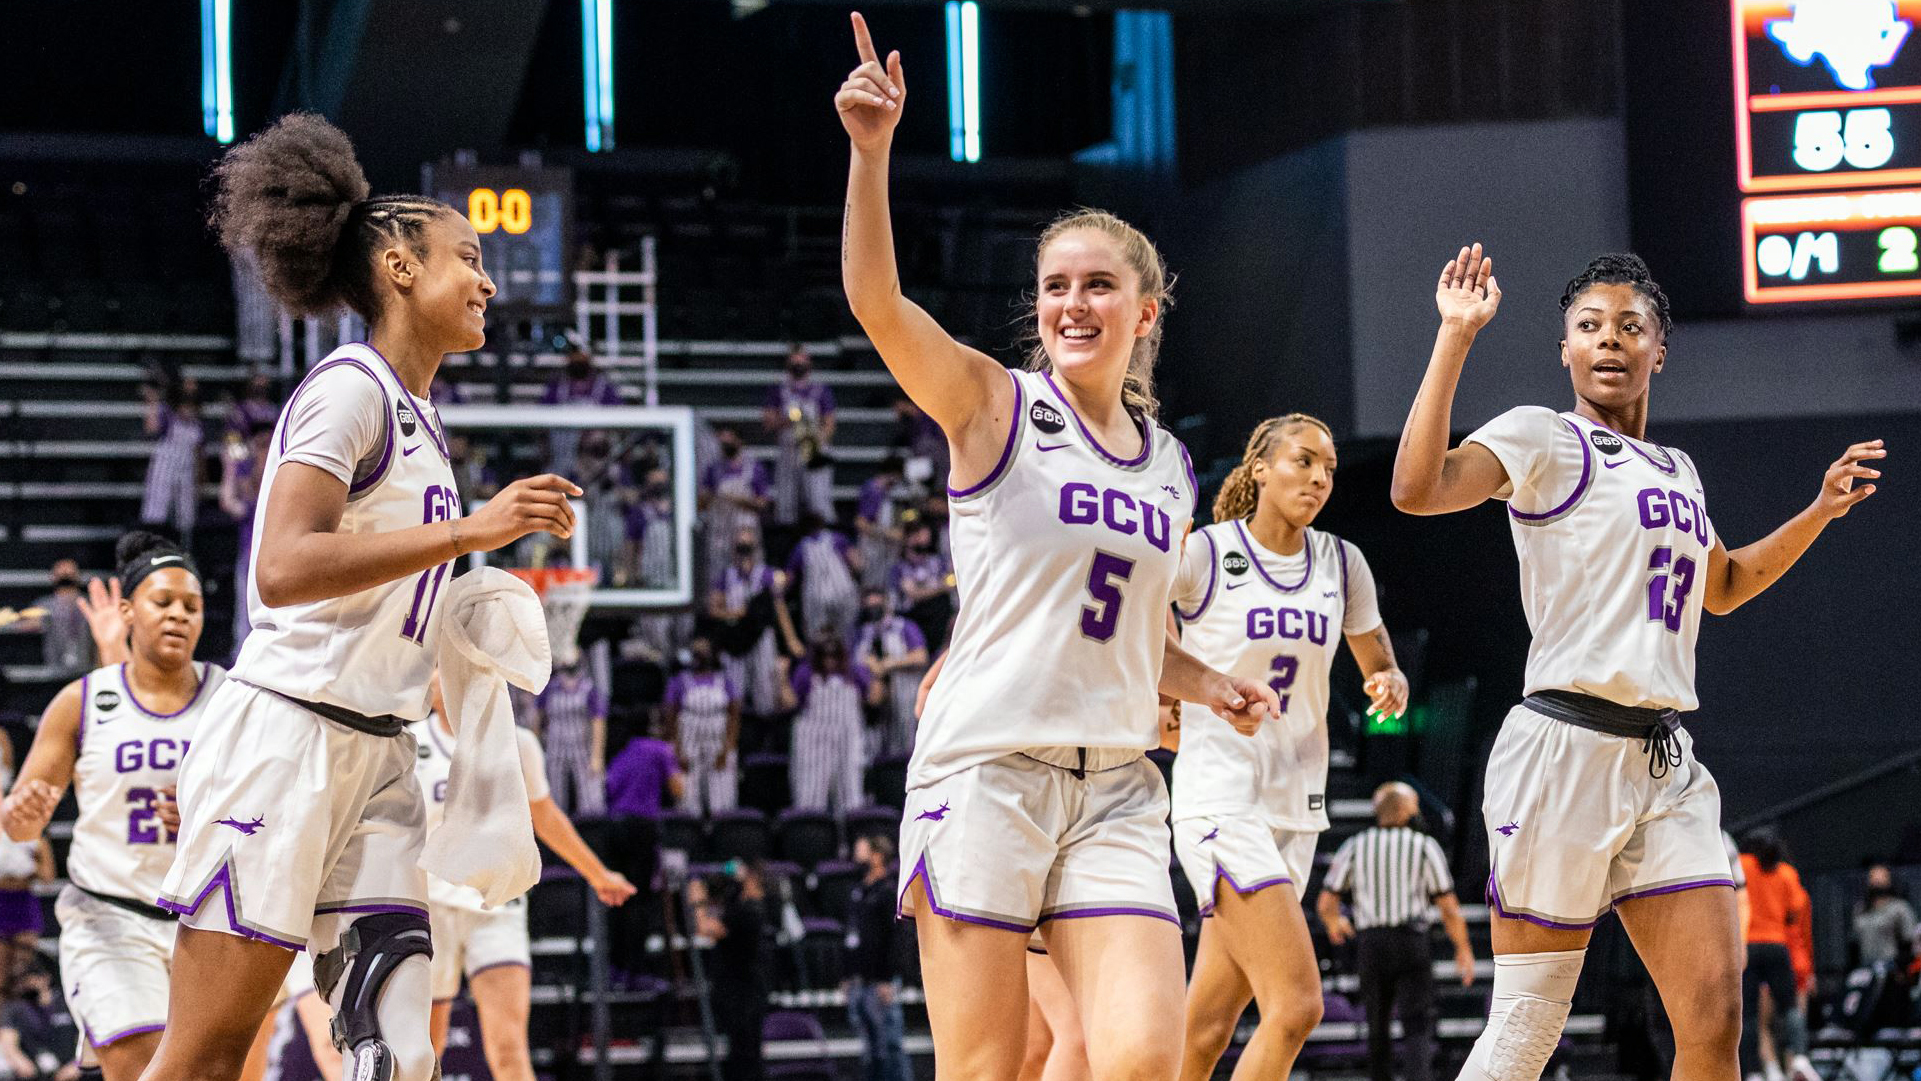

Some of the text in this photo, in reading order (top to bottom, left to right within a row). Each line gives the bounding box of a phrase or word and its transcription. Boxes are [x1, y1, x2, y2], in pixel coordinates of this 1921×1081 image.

[1792, 108, 1894, 171] 55
[1757, 232, 1840, 280] 0/1
[1878, 226, 1919, 272] 2
[423, 485, 463, 525] GC
[1059, 482, 1170, 553] GCU
[1637, 487, 1708, 548] GCU
[399, 562, 449, 648] 11
[1078, 547, 1137, 645] 5
[1646, 544, 1696, 635] 23
[1247, 606, 1328, 646] GCU
[1268, 653, 1299, 714] 2
